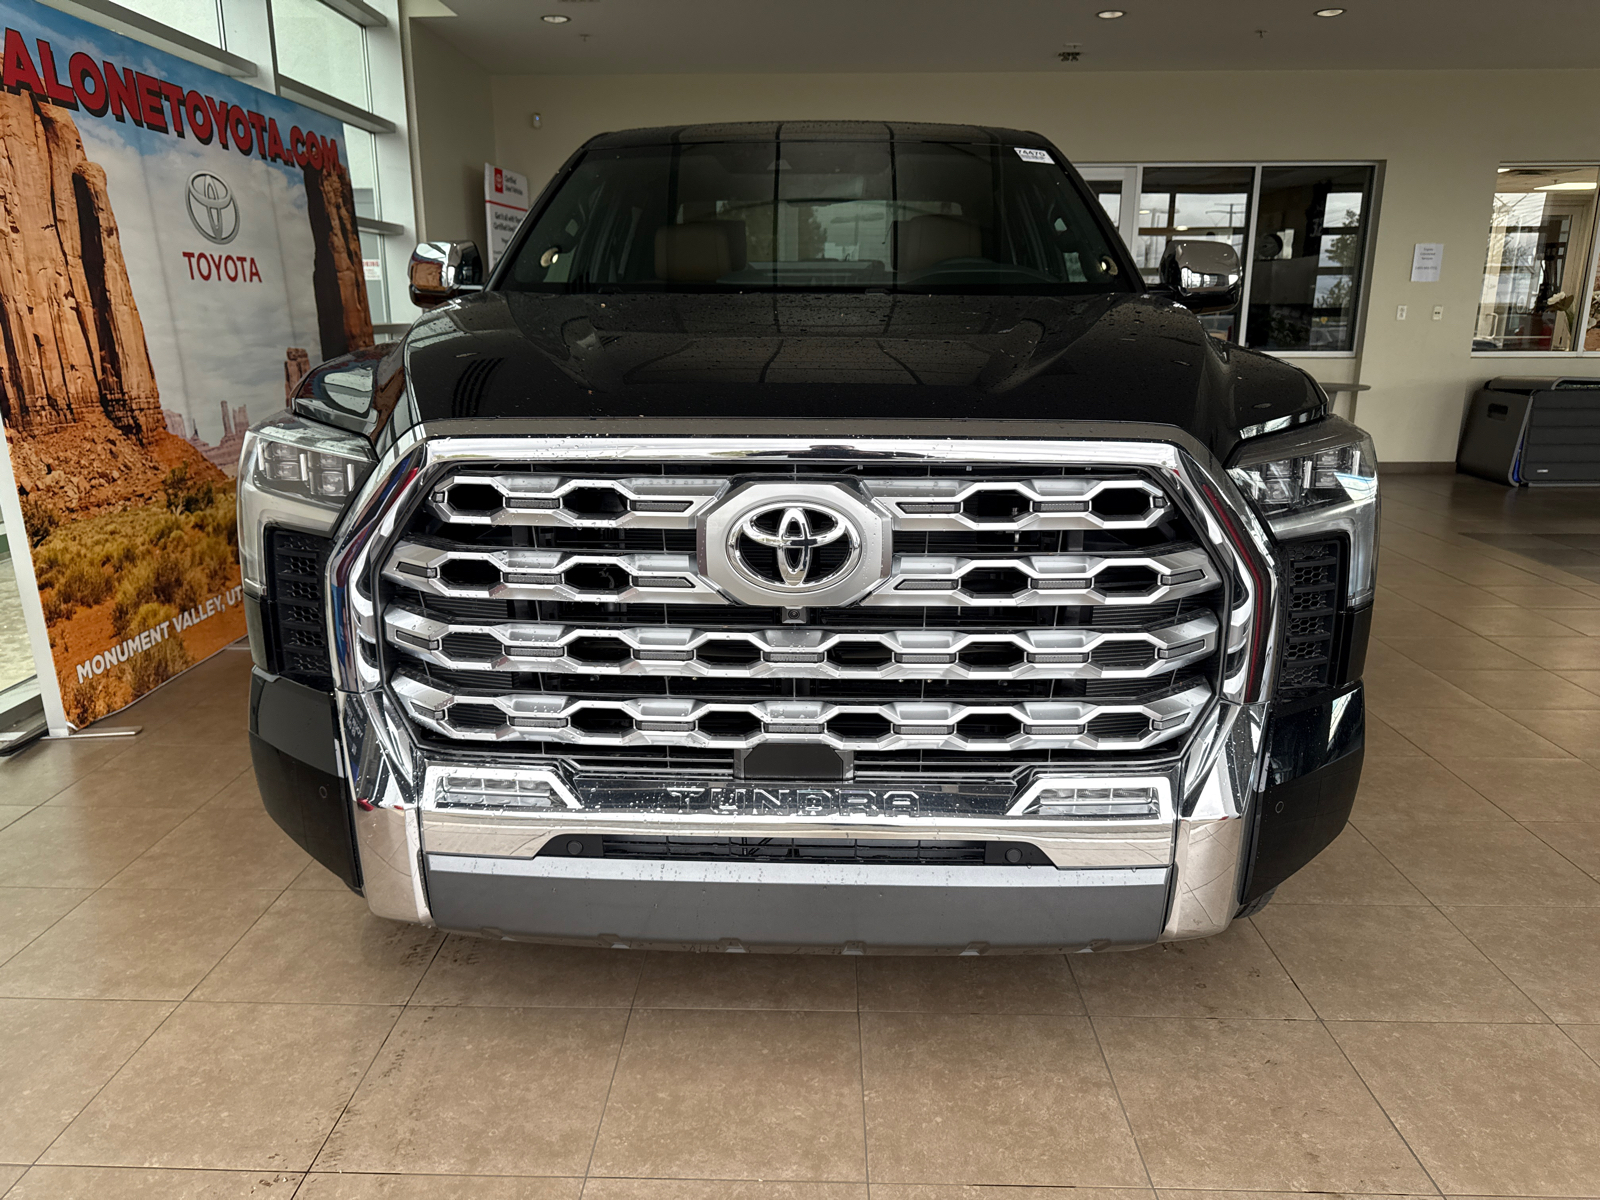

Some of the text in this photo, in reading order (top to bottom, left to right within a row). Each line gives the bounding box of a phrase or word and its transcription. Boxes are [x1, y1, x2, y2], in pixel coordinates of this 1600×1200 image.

[182, 251, 263, 283] TOYOTA
[76, 620, 170, 684] MONUMENT
[172, 594, 226, 633] VALLEY,
[666, 787, 919, 817] TUNDRA
